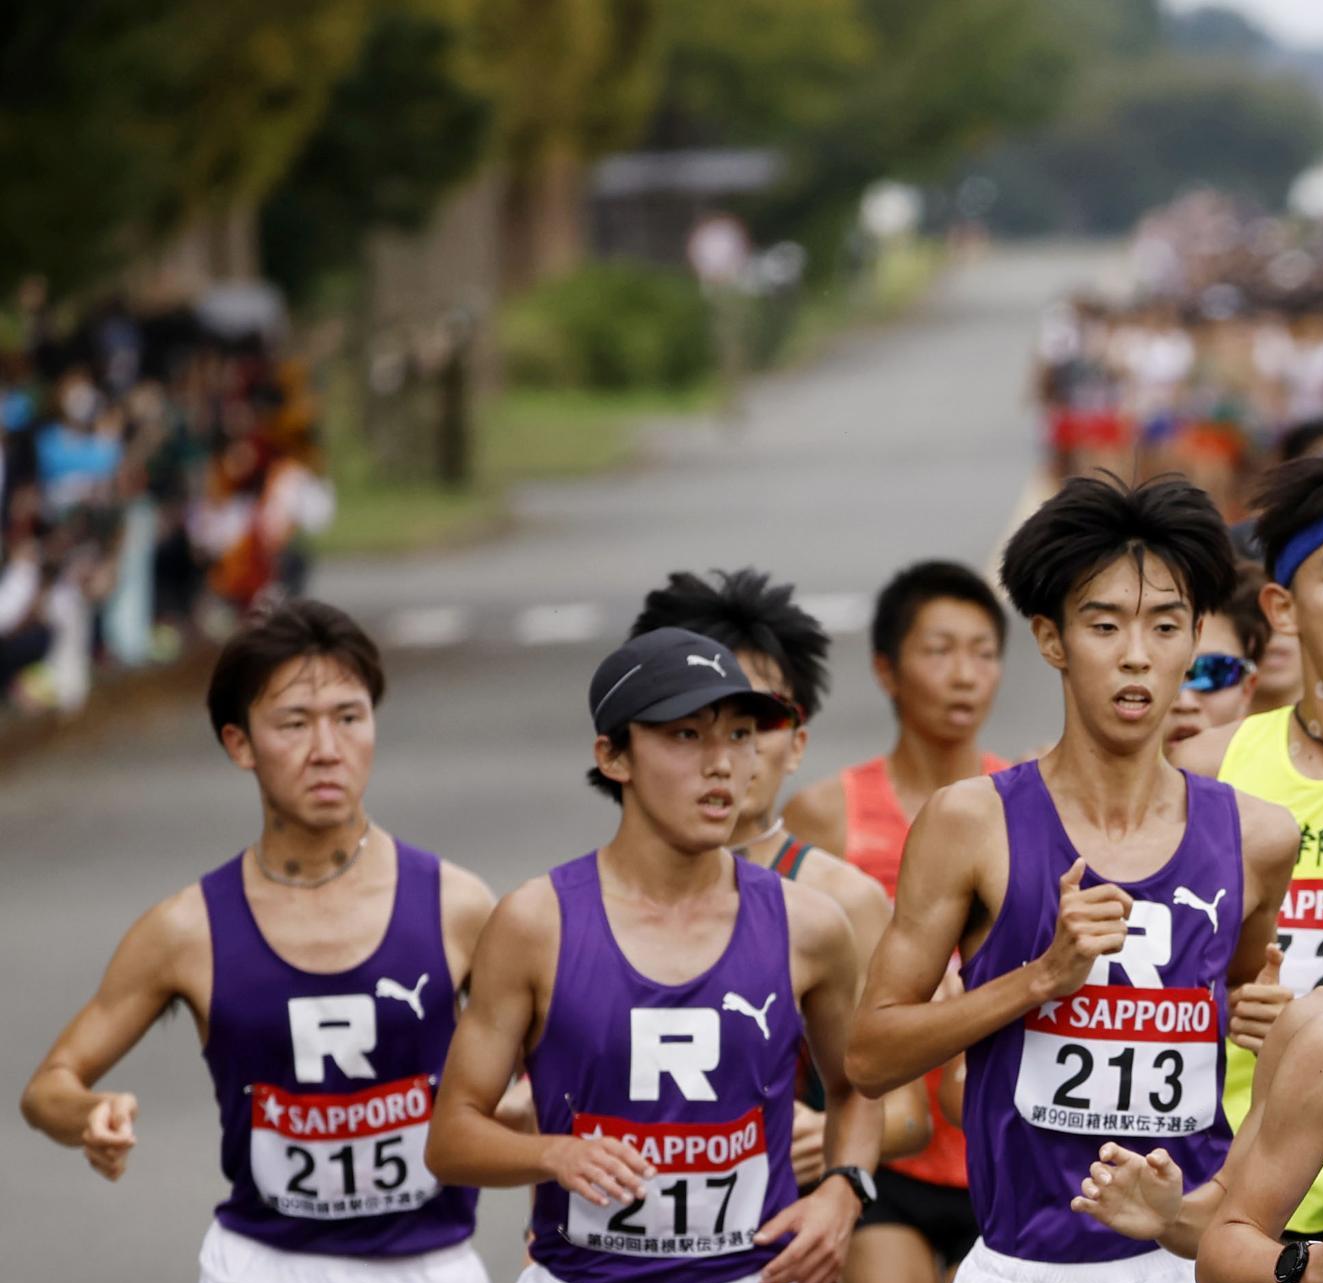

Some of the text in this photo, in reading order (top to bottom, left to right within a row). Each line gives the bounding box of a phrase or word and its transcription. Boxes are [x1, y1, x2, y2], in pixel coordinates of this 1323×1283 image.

[1083, 900, 1172, 989] R
[289, 994, 377, 1083] R
[1069, 996, 1211, 1032] SAPPORO
[629, 1007, 721, 1101] R
[1052, 1043, 1184, 1113] 213
[287, 1087, 427, 1135] SAPPORO
[1031, 1104, 1199, 1133] 第99回箱根駅伝予選会
[286, 1136, 408, 1198] 215
[607, 1172, 738, 1236] 217
